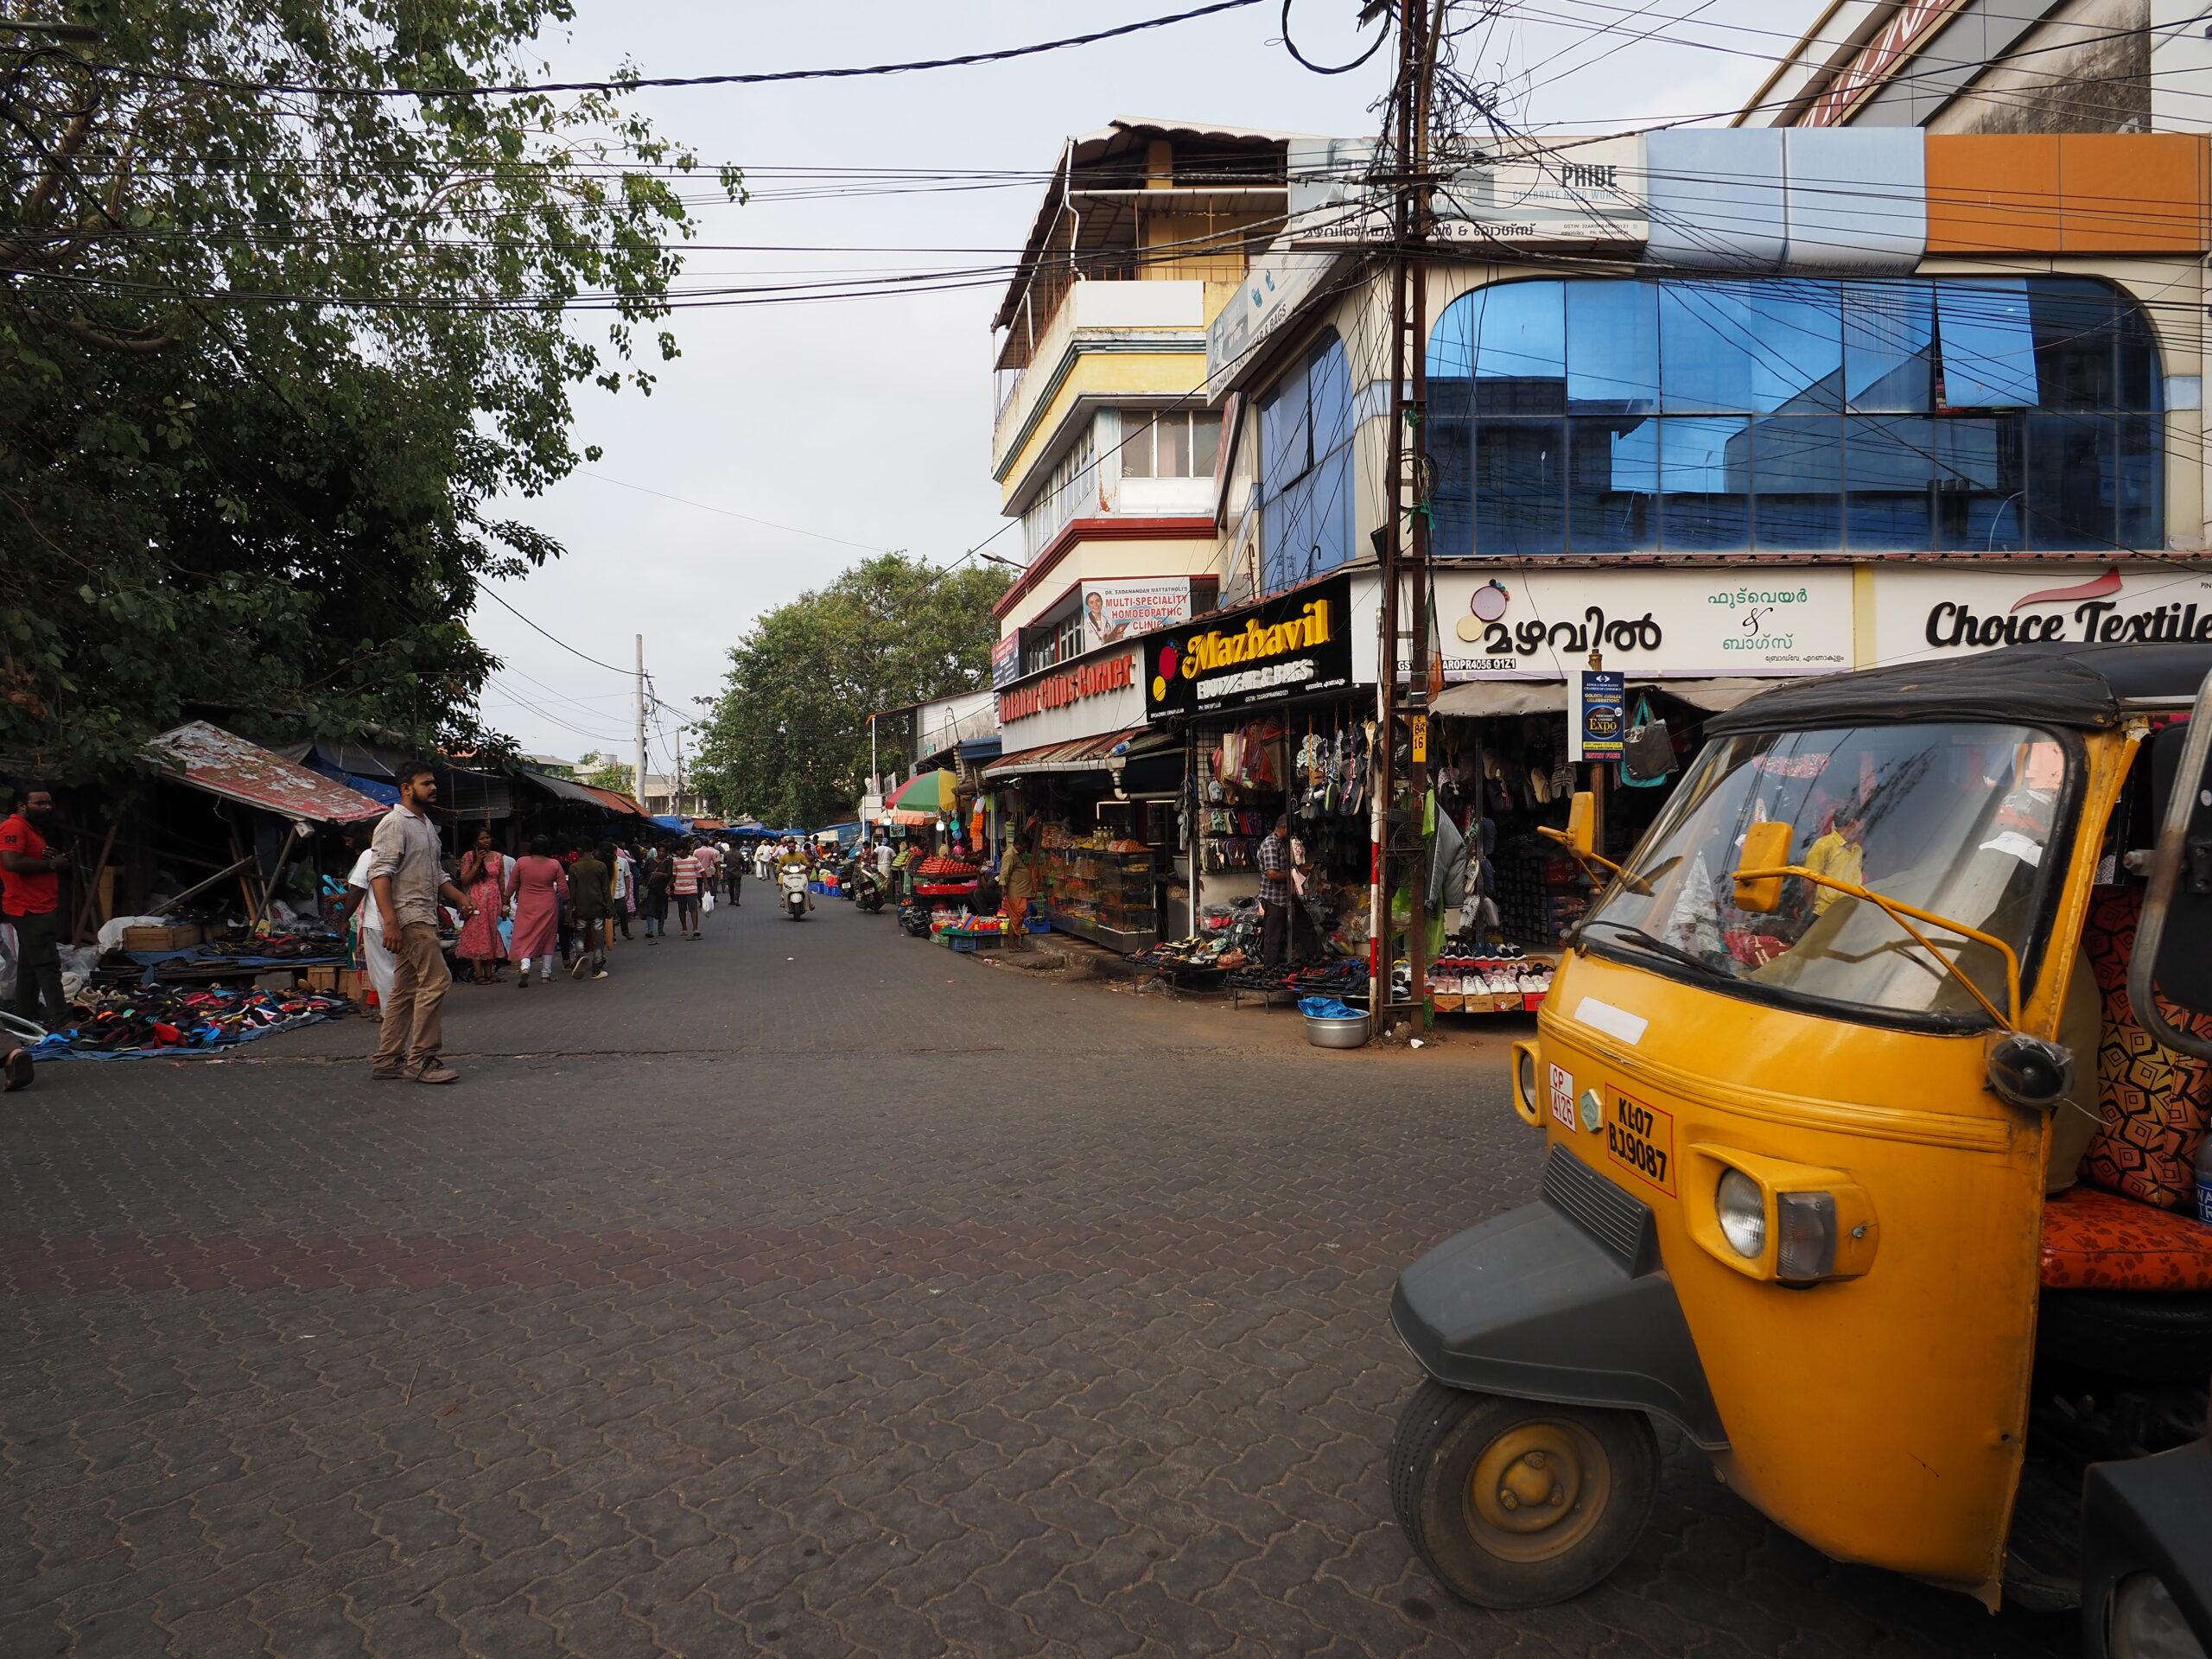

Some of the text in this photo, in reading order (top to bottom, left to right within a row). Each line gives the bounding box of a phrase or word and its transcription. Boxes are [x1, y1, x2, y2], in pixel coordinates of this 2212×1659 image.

[1562, 165, 1617, 188] PRIDE
[1513, 190, 1559, 200] CELEBRATE
[1459, 226, 1468, 236] &
[1269, 303, 1287, 330] BAGS
[1106, 594, 1188, 607] MULTI-SPECIALITY
[1112, 607, 1183, 619] HOMOEOPATHIC
[1742, 607, 1774, 637] &
[1925, 601, 2066, 646] Choice
[1133, 620, 1163, 630] CLINIC
[1484, 606, 1662, 656] മഴവിൽ
[1182, 599, 1332, 679] Mazhavil
[1493, 659, 1516, 670] Q1Z1
[999, 688, 1039, 723] Malabar
[1040, 673, 1077, 709] Chips
[1077, 654, 1135, 697] Corner
[1197, 658, 1314, 700] FOOTWEAR & BAGS
[1414, 724, 1426, 734] BR
[1590, 719, 1618, 733] Expo
[1414, 737, 1424, 749] 16
[1553, 1068, 1564, 1090] CP
[1553, 1091, 1573, 1126] 4126
